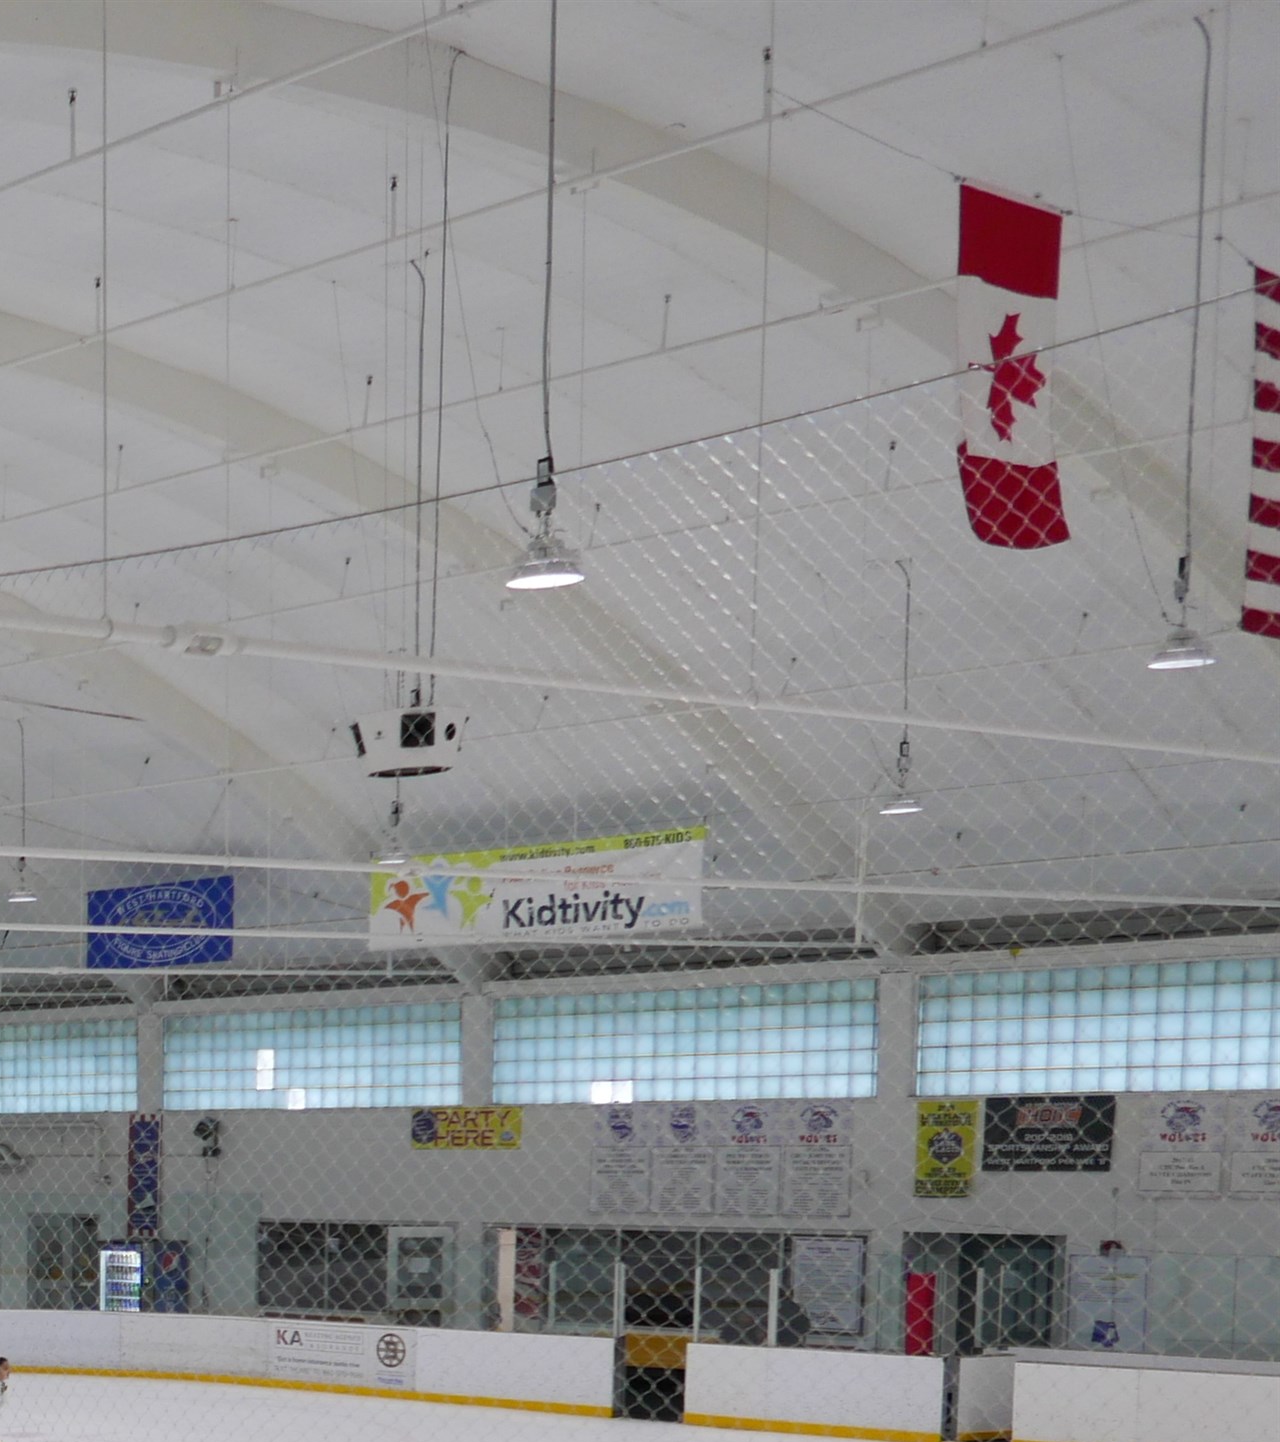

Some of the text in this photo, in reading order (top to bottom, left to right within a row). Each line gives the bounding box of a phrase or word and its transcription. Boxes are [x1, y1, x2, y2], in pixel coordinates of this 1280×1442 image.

[116, 889, 204, 915] WEST HARTFORD
[644, 919, 662, 929] TO
[435, 1110, 513, 1128] PARTY
[434, 1129, 495, 1147] HERE
[276, 1329, 304, 1346] KA
